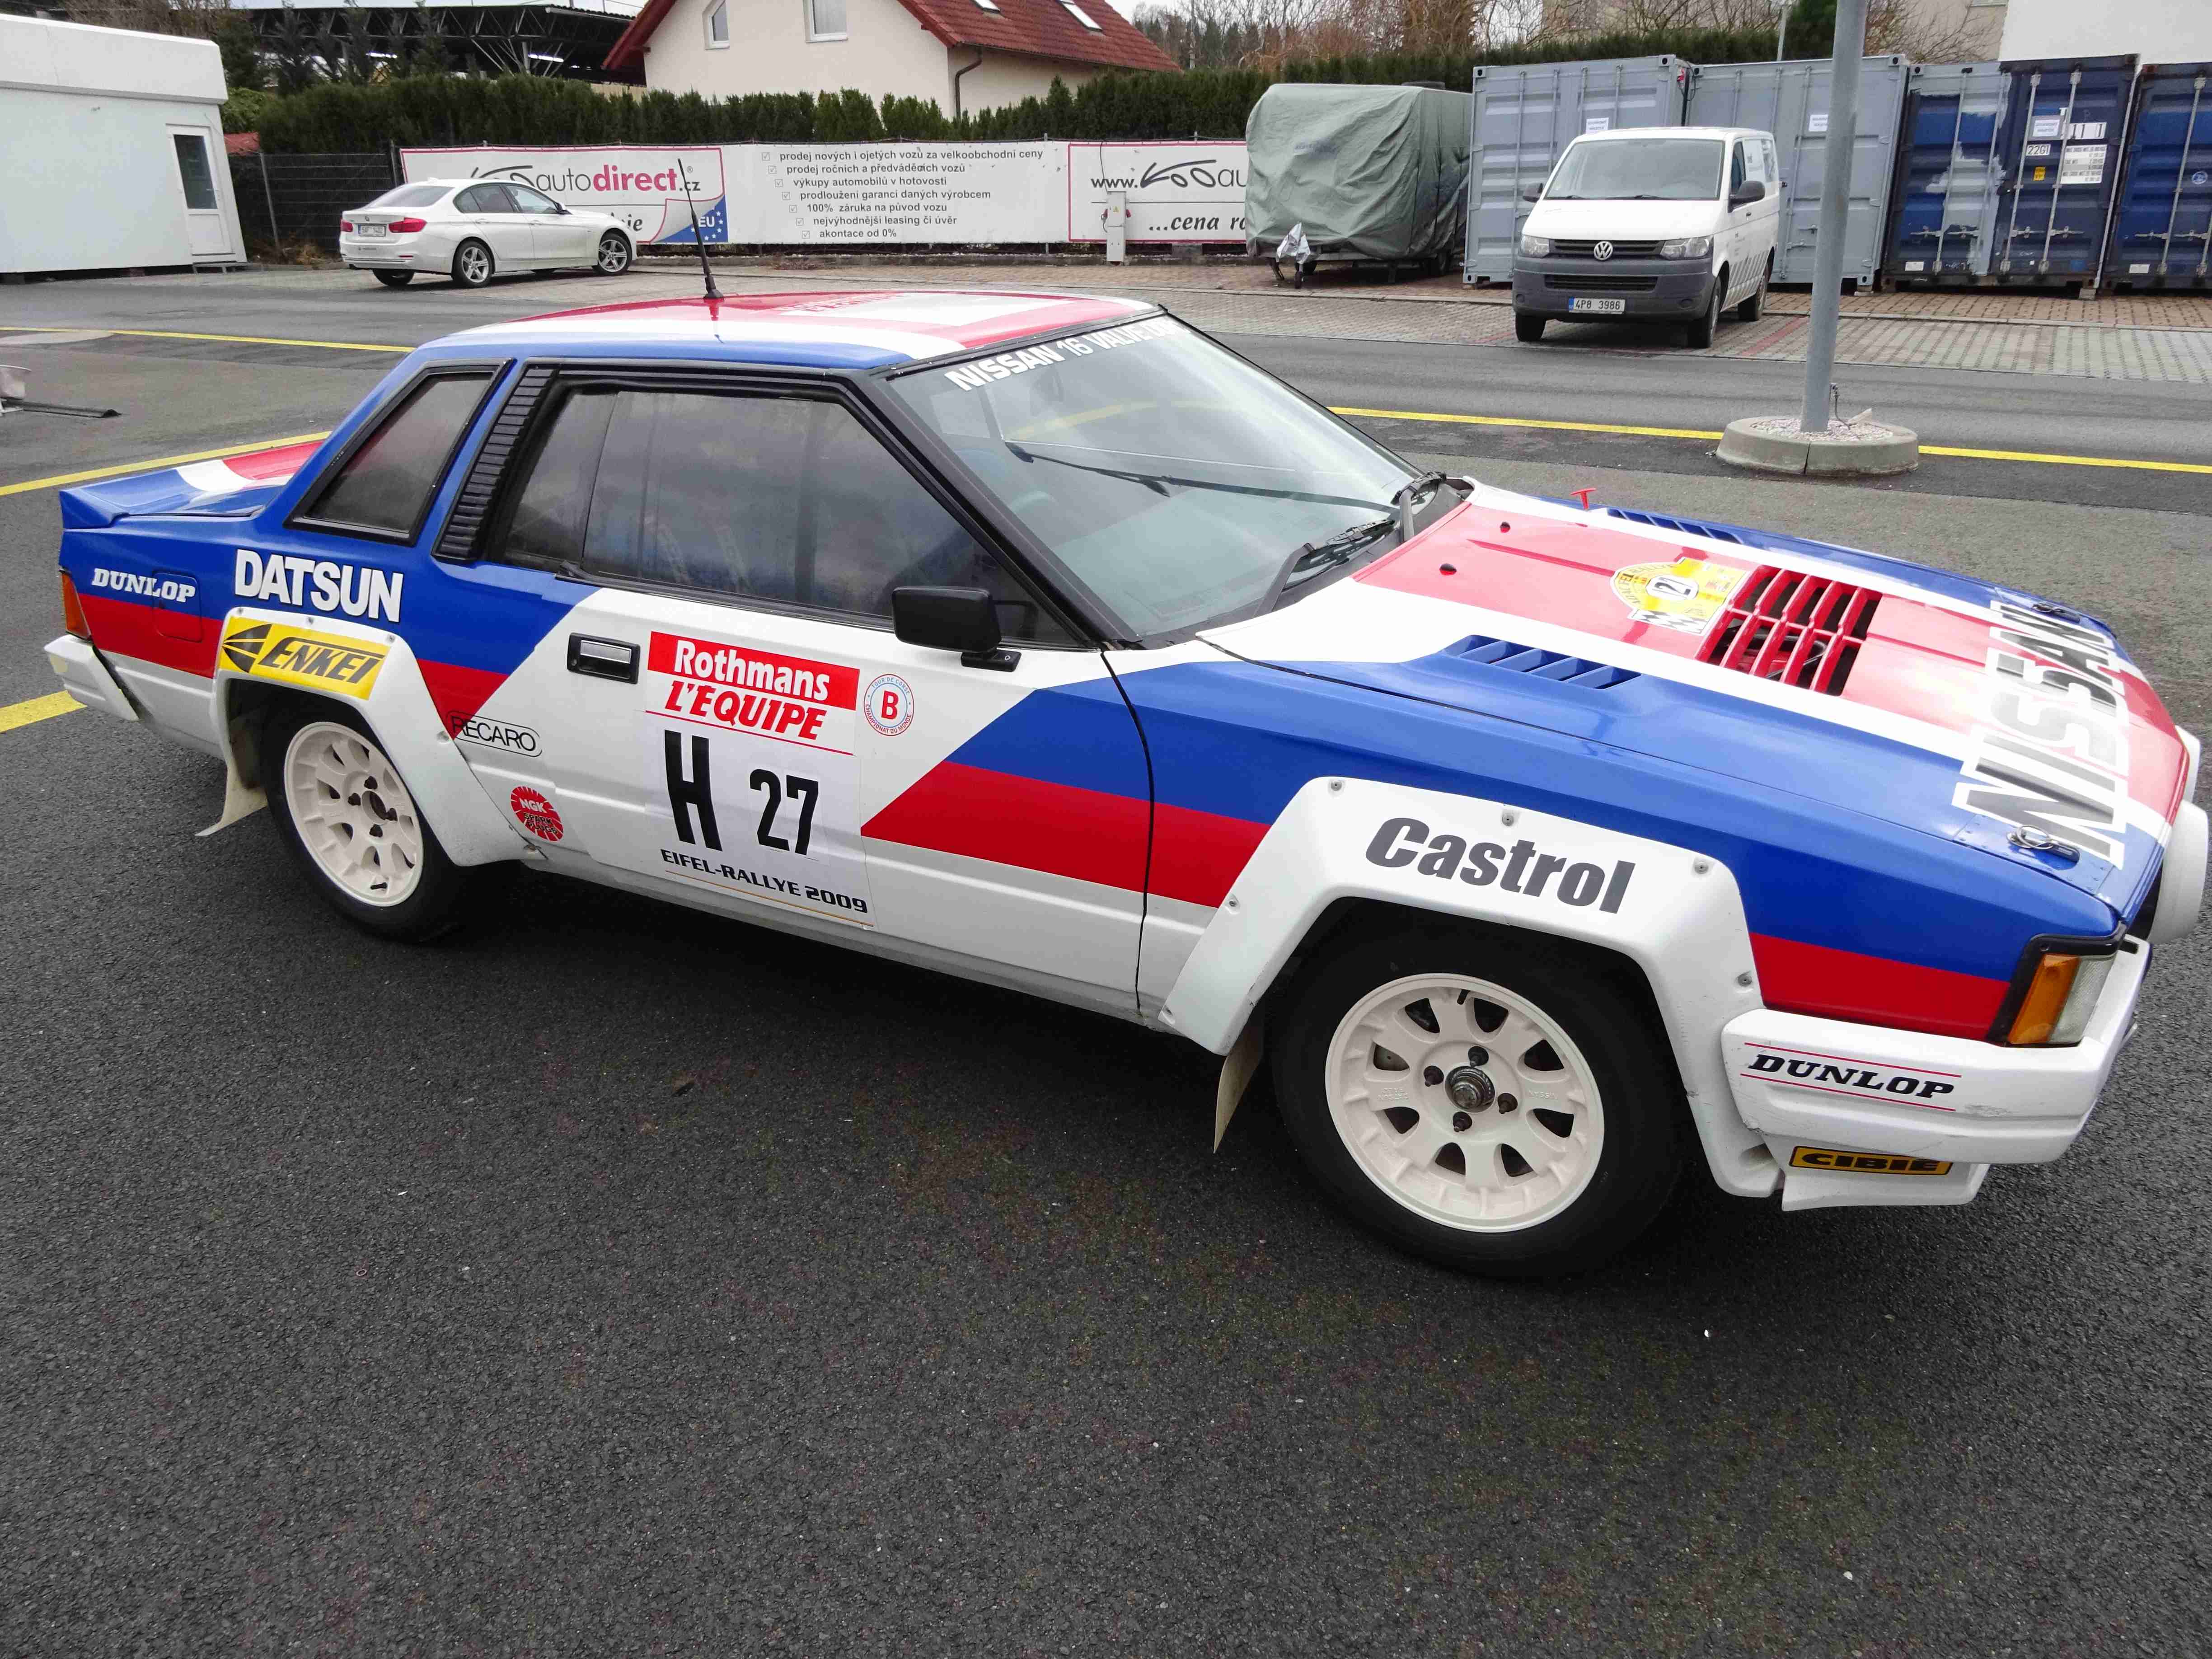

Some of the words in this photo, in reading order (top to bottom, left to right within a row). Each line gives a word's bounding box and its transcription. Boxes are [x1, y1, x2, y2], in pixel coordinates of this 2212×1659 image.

[780, 152, 811, 162] prodej
[815, 151, 851, 162] nových
[854, 151, 857, 159] i
[860, 150, 896, 161] ojetých
[941, 150, 1016, 159] velkoobchodní
[1019, 150, 1043, 160] ceny
[787, 165, 819, 175] prodej
[941, 163, 965, 173] vozů
[536, 164, 701, 192] autodirect.cz
[793, 178, 829, 188] výkupy
[832, 176, 888, 186] automobilů
[899, 176, 947, 186] hotovosti
[1090, 178, 1138, 188] www.
[800, 190, 859, 201] prodloužení
[862, 190, 898, 201] garancí
[901, 189, 937, 200] daných
[941, 190, 991, 201] výrobcem
[807, 203, 834, 212] 100%
[839, 203, 872, 212] záruka
[889, 202, 920, 213] původ
[698, 216, 715, 228] EU
[813, 216, 882, 227] nejvýhodnější
[884, 216, 920, 226] leasing
[923, 215, 932, 225] či
[935, 215, 958, 225] úvěr
[819, 229, 864, 238] akontace
[867, 229, 879, 238] od
[882, 228, 897, 238] 0%
[1575, 300, 1592, 309] 4P8
[1598, 300, 1620, 310] 3986
[944, 345, 1066, 391] NISSAN
[1056, 337, 1094, 357] 16
[1082, 326, 1153, 350] VALVE
[91, 567, 196, 603] DUNLOP
[234, 548, 405, 623] DATSUN
[258, 636, 386, 684] ENKEI
[675, 640, 830, 702] Rothmans
[871, 677, 886, 689] TOUR
[895, 678, 910, 696] CORSE
[664, 680, 827, 741] L'EQUIPE
[881, 690, 899, 720] B
[865, 703, 890, 734] CHAMPIONAT
[898, 713, 912, 731] MONDE
[450, 715, 536, 752] RECARO
[1952, 600, 2128, 870] NISSAN
[518, 797, 548, 814] NGK
[663, 729, 723, 852] H
[750, 769, 820, 856] 27
[524, 812, 553, 825] SPARK
[528, 821, 559, 835] PLUGS
[1365, 817, 1636, 914] Castrol
[660, 848, 800, 897] EIFEL-RALLYE
[805, 885, 868, 914] 2009
[1748, 1053, 1955, 1099] DUNLOP
[1800, 1149, 1940, 1173] CIBIE
